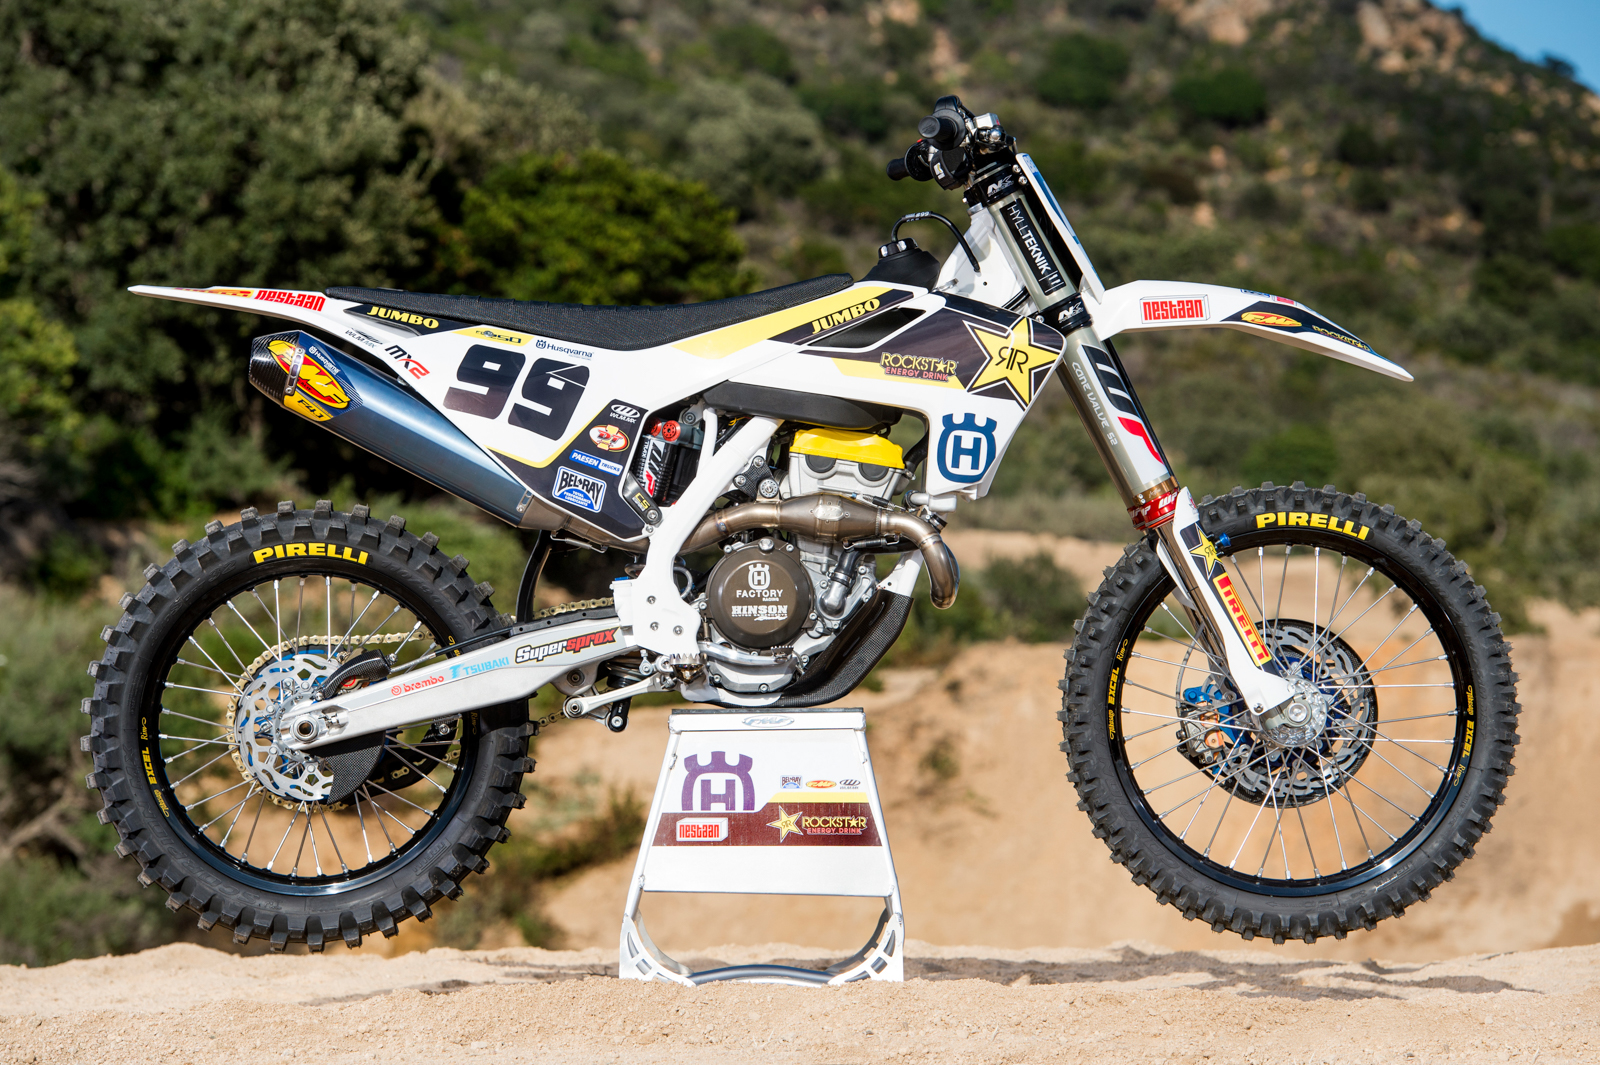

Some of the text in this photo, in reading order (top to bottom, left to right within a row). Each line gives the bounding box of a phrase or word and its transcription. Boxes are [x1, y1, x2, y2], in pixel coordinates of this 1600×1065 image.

[1007, 202, 1052, 275] HYLLTEKNIK
[254, 289, 326, 312] nestaan
[1142, 299, 1204, 321] nestaan
[366, 306, 439, 329] JUMBO
[812, 298, 881, 335] JUMBO
[547, 343, 593, 358] Husqvarna
[385, 345, 430, 380] MX2
[885, 366, 949, 382] ENERGY DRINK
[443, 344, 590, 441] 99
[571, 452, 621, 472] PAESEN TRUCKS
[1255, 511, 1370, 541] PIRELLI
[253, 542, 369, 565] PIRELLI
[736, 589, 784, 598] FACTORY
[731, 605, 788, 615] HINSON
[1217, 575, 1270, 661] PIRELLI
[463, 656, 510, 676] TSUBAKI
[403, 675, 445, 693] brembo
[1108, 667, 1119, 705] EXCEL
[1462, 719, 1475, 758] EXCEL
[142, 747, 157, 785] EXCEL
[679, 823, 720, 839] nestaan
